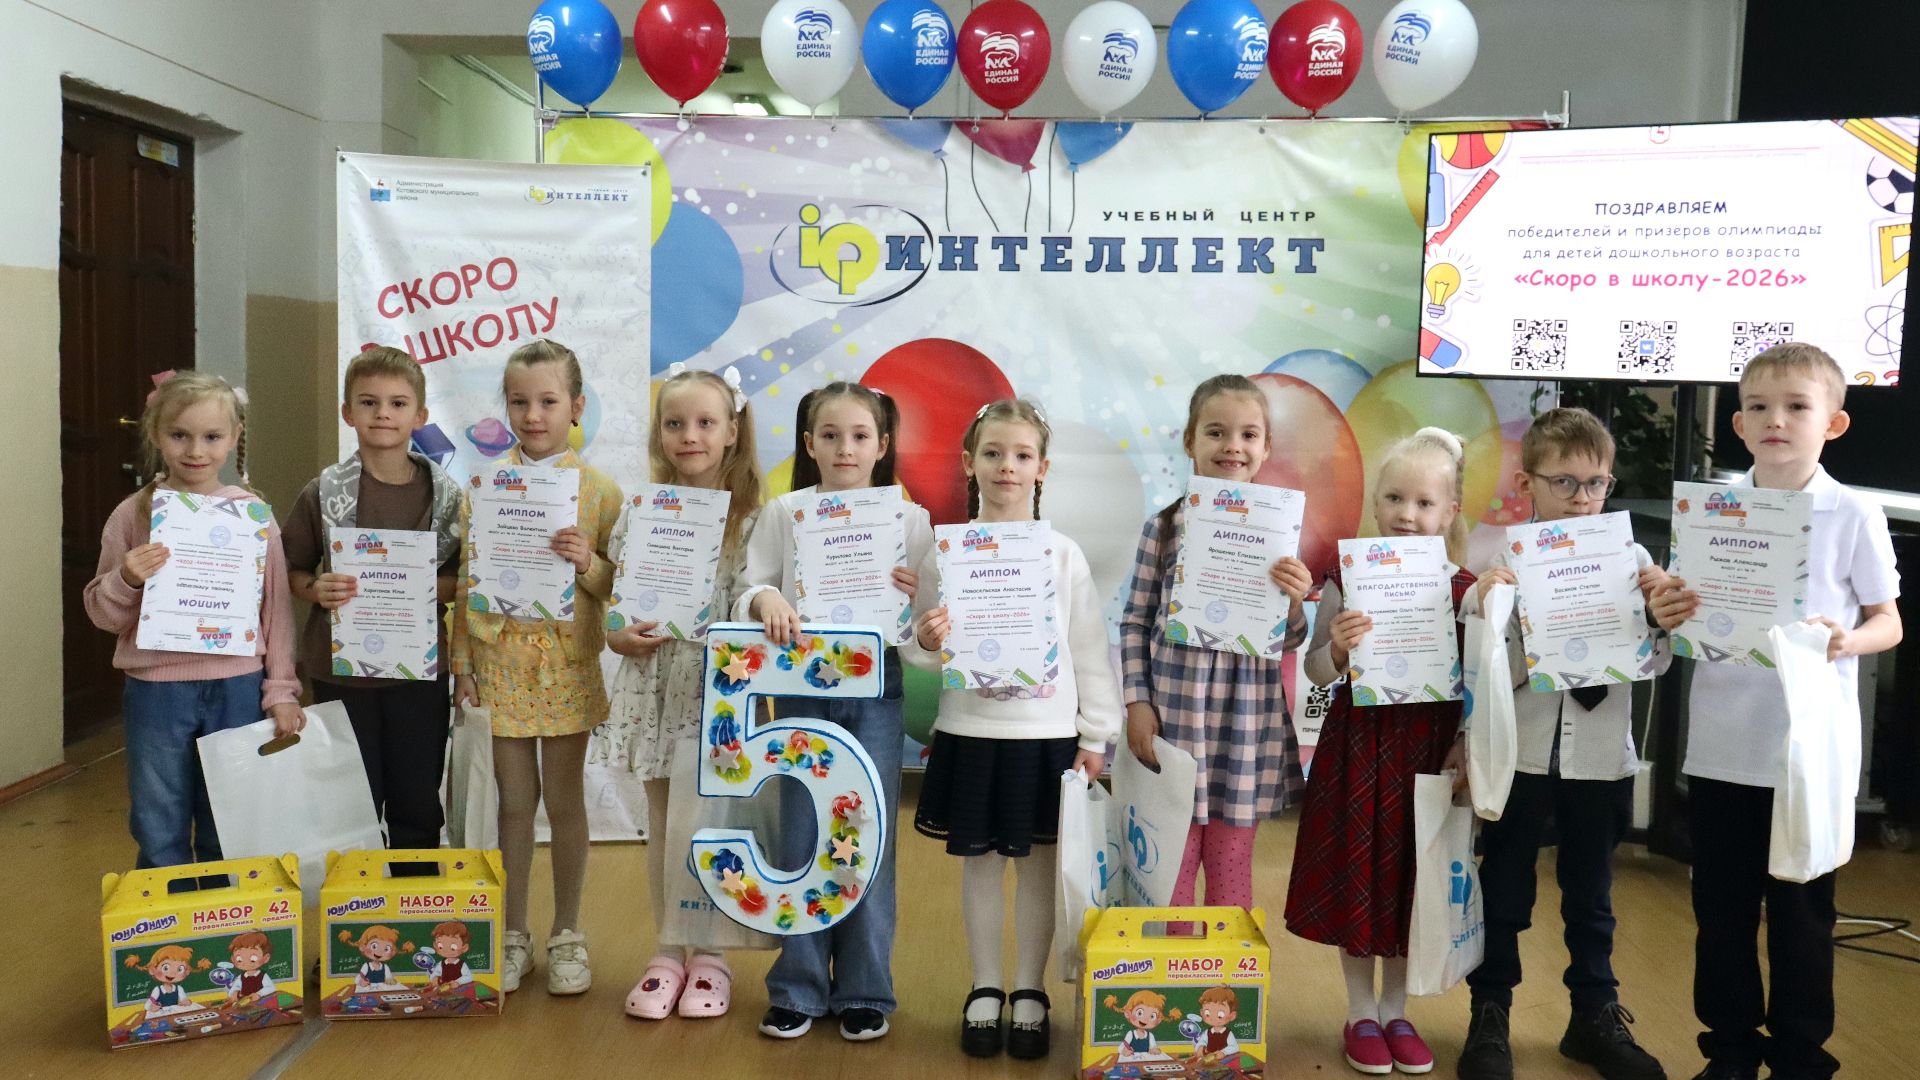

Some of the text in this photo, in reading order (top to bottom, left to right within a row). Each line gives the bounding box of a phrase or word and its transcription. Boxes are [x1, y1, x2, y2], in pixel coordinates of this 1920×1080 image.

[796, 42, 832, 50] ЕДИНАЯ
[1387, 44, 1421, 58] ЕДИНАЯ
[796, 50, 831, 59] РОССИЯ
[915, 48, 948, 58] ЕДИНАЯ
[1385, 51, 1419, 66] РОССИЯ
[915, 57, 948, 65] РОССИЯ
[1308, 59, 1344, 70] ЕДИНАЯ
[984, 68, 1019, 77] ЕДИНАЯ
[1099, 63, 1133, 73] ЕДИНАЯ
[1308, 67, 1343, 77] РОССИЯ
[985, 76, 1019, 85] РОССИЯ
[1098, 70, 1131, 81] РОССИЯ
[396, 179, 444, 188] Администрация
[547, 191, 628, 201] ИНТЕЛЛЕКТ
[1595, 201, 1728, 216] ПОЗДРАВЛЯЕМ
[1102, 208, 1318, 223] УЧЕБНЫЙ ЦЕНТР
[1508, 224, 1822, 239] победителей и призеров олимпиады
[885, 235, 1325, 274] ИНТЕЛЛЕКТ
[1523, 246, 1800, 260] для детей дошкольного возраста
[1514, 269, 1596, 291] «Скоро
[1609, 274, 1619, 286] в
[377, 256, 518, 318] СКОРО
[404, 296, 559, 365] ШКОЛУ
[493, 478, 523, 486] ШКОЛУ
[653, 497, 680, 505] ШКОЛУ
[1213, 499, 1246, 507] ШКОЛУ
[1705, 502, 1742, 511] ШКОЛУ
[498, 508, 546, 519] ДИПЛОМ
[816, 503, 846, 516] ШКОЛУ
[651, 526, 695, 538] ДИПЛОМ
[1213, 530, 1265, 545] ДИПЛОМ
[823, 532, 873, 546] ДИПЛОМ
[962, 536, 994, 547] ШКОЛУ
[1536, 532, 1569, 547] ШКОЛУ
[1709, 536, 1769, 550] ДИПЛОМ
[354, 541, 383, 550] ШКОЛУ
[1366, 550, 1396, 562] ШКОЛУ
[359, 571, 407, 580] ДИПЛОМ
[970, 568, 1021, 579] ДИПЛОМ
[1547, 563, 1601, 580] ДИПЛОМ
[1357, 581, 1439, 591] БЛАГОДАРСТВЕННОЕ
[1384, 590, 1416, 598] ПИСЬМО
[178, 598, 230, 609] ДИПЛОМ
[200, 632, 232, 640] ШКОЛУ
[400, 895, 455, 907] НАБОР
[469, 895, 488, 907] 42
[269, 900, 289, 914] 42
[193, 905, 253, 924] НАБОР
[262, 913, 297, 923] предмета
[193, 919, 253, 931] первоклассника
[1168, 958, 1223, 971] НАБОР
[1238, 958, 1257, 971] 42
